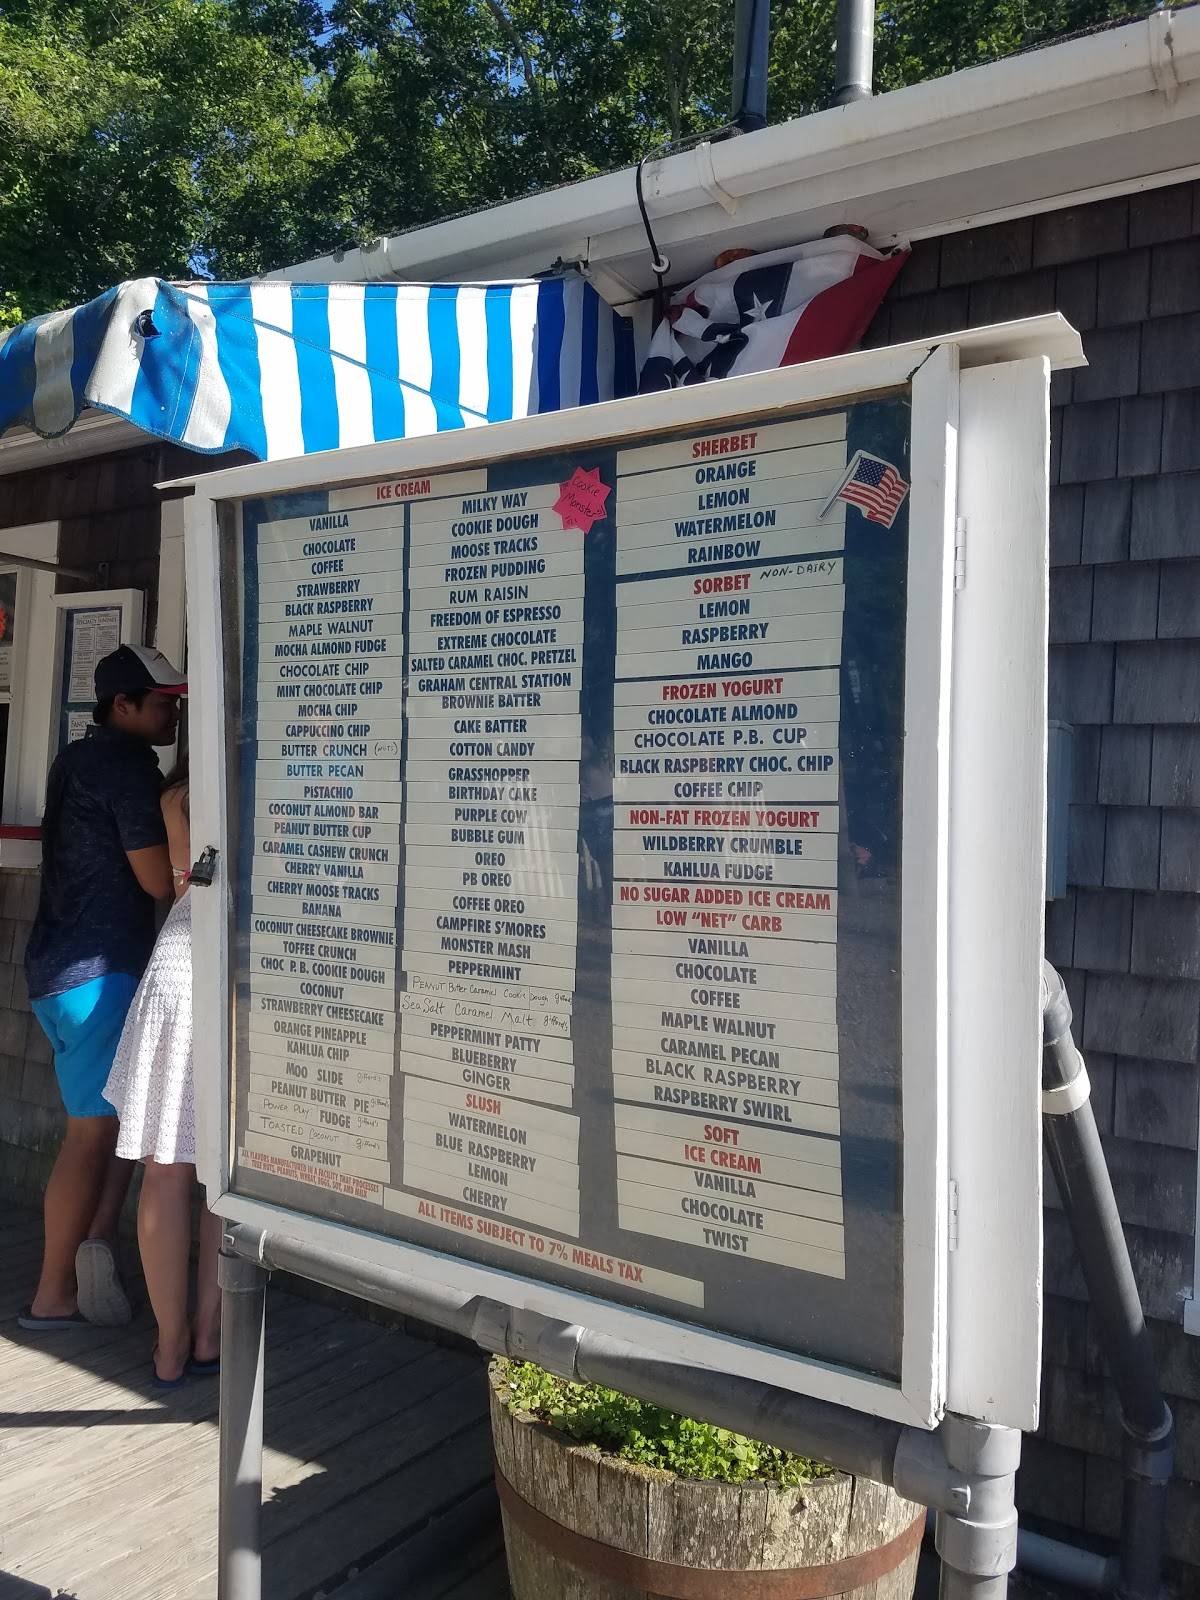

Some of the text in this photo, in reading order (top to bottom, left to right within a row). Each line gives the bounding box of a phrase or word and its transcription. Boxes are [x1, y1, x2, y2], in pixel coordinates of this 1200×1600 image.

[692, 433, 758, 458] SHERBET
[695, 460, 756, 484] ORANGE
[377, 480, 431, 500] ICE CREAM
[698, 488, 750, 510] LEMON
[462, 493, 528, 514] MILKY WAY
[310, 514, 349, 531] VANILLA
[452, 514, 539, 537] COOKIE DOUGH
[675, 510, 776, 537] WATERMELON
[303, 538, 356, 556] CHOCOLATE
[451, 537, 538, 559] MOOSE TRACKS
[688, 541, 761, 564] RAINBOW
[312, 559, 343, 575] COFFEE
[445, 559, 545, 582] FROZEN PUDDING
[297, 579, 360, 598] STRAWBERRY
[694, 574, 751, 594] SORBET
[450, 586, 528, 604] RUM RAISIN
[286, 598, 373, 616] BLACK RASPBERRY
[431, 606, 561, 627] FREEDOM OF ESPRESSO
[699, 599, 750, 618] LEMON
[289, 620, 373, 637] MAPLE WALNUT
[682, 623, 769, 645] RASPBERRY
[275, 639, 387, 656] MOCHA ALMOND FUDGE
[438, 629, 557, 650] EXTREME CHOCOLATE
[280, 663, 370, 677] CHOCOLATE CHIP
[411, 649, 576, 672] SALTED CARAMEL CHOC. PRETZEL
[697, 652, 752, 670] MANGO
[663, 678, 784, 700] FROZEN YOGURT
[298, 704, 358, 717] MOCHA CHIP
[648, 703, 798, 724] CHOCOLATE ALMOND
[454, 719, 527, 733] CAKE BATTER
[634, 728, 807, 748] CHOCOLATE P.B. CUP
[281, 744, 367, 756] BUTTER CRUNCH
[287, 765, 364, 777] BUTTER PECAN
[448, 768, 530, 781] GRASSHOPPER
[620, 756, 833, 774] BLACK RASPBERRY CHOC. CHIP
[304, 786, 353, 799] PISTACHIO
[269, 803, 379, 819] COCONUT ALMOND BAR
[630, 810, 819, 828] NON-FAT FROZEN YOGURT
[274, 822, 371, 839] PEANUT BUTTER CUP
[451, 829, 525, 844] BUBBLE GUM
[643, 836, 803, 855] WILDBERRY CRUMBLE
[475, 852, 506, 866] OREO
[267, 881, 380, 900] CHERRY MOOSE TRACKS
[621, 887, 831, 910] NO SUGAR ADDED ICE CREAM
[302, 902, 342, 917] BANANA
[453, 896, 525, 913] COFFEE OREO
[437, 916, 546, 939] CAMPFIRE S'MORES
[656, 910, 688, 926] LOW
[742, 915, 782, 932] CARB
[688, 938, 749, 957] VANILLA
[449, 960, 521, 980] PEPPERMINT
[675, 962, 757, 984] CHOCOLATE
[300, 983, 344, 999] COCONUT
[691, 988, 741, 1009] COFFEE
[261, 998, 384, 1026] STRAWBERRY CHEESECAKE
[501, 1012, 532, 1026] Malt
[661, 1012, 776, 1039] MAPLE WALNUT
[431, 1022, 541, 1053] PEPPERMINT PATTY
[287, 1041, 350, 1061] KAHLUA CHIP
[452, 1047, 517, 1072] BLUEBERRY
[661, 1038, 780, 1069] CARAMEL PECAN
[463, 1069, 511, 1091] GINGER
[646, 1058, 801, 1097] BLACK RASPBERRY
[466, 1094, 501, 1115] SLUSH
[654, 1086, 792, 1123] RASPBERRY SWIRL
[320, 1110, 350, 1128] FUDGE
[449, 1112, 527, 1145] WATERMELON
[704, 1125, 739, 1145] SOFT
[291, 1145, 341, 1167] GRAPENUT
[436, 1133, 536, 1172] BLUE RASPBERRY
[684, 1144, 762, 1174] ICE CREAM
[468, 1162, 508, 1186] LEMON
[694, 1171, 756, 1198] VANILLA
[463, 1186, 508, 1212] CHERRY
[681, 1197, 764, 1230] CHOCOLATE
[418, 1200, 643, 1284] ALL ITEMS SUBJECT TO 7% MEALS TAX
[703, 1228, 749, 1252] TWIST
